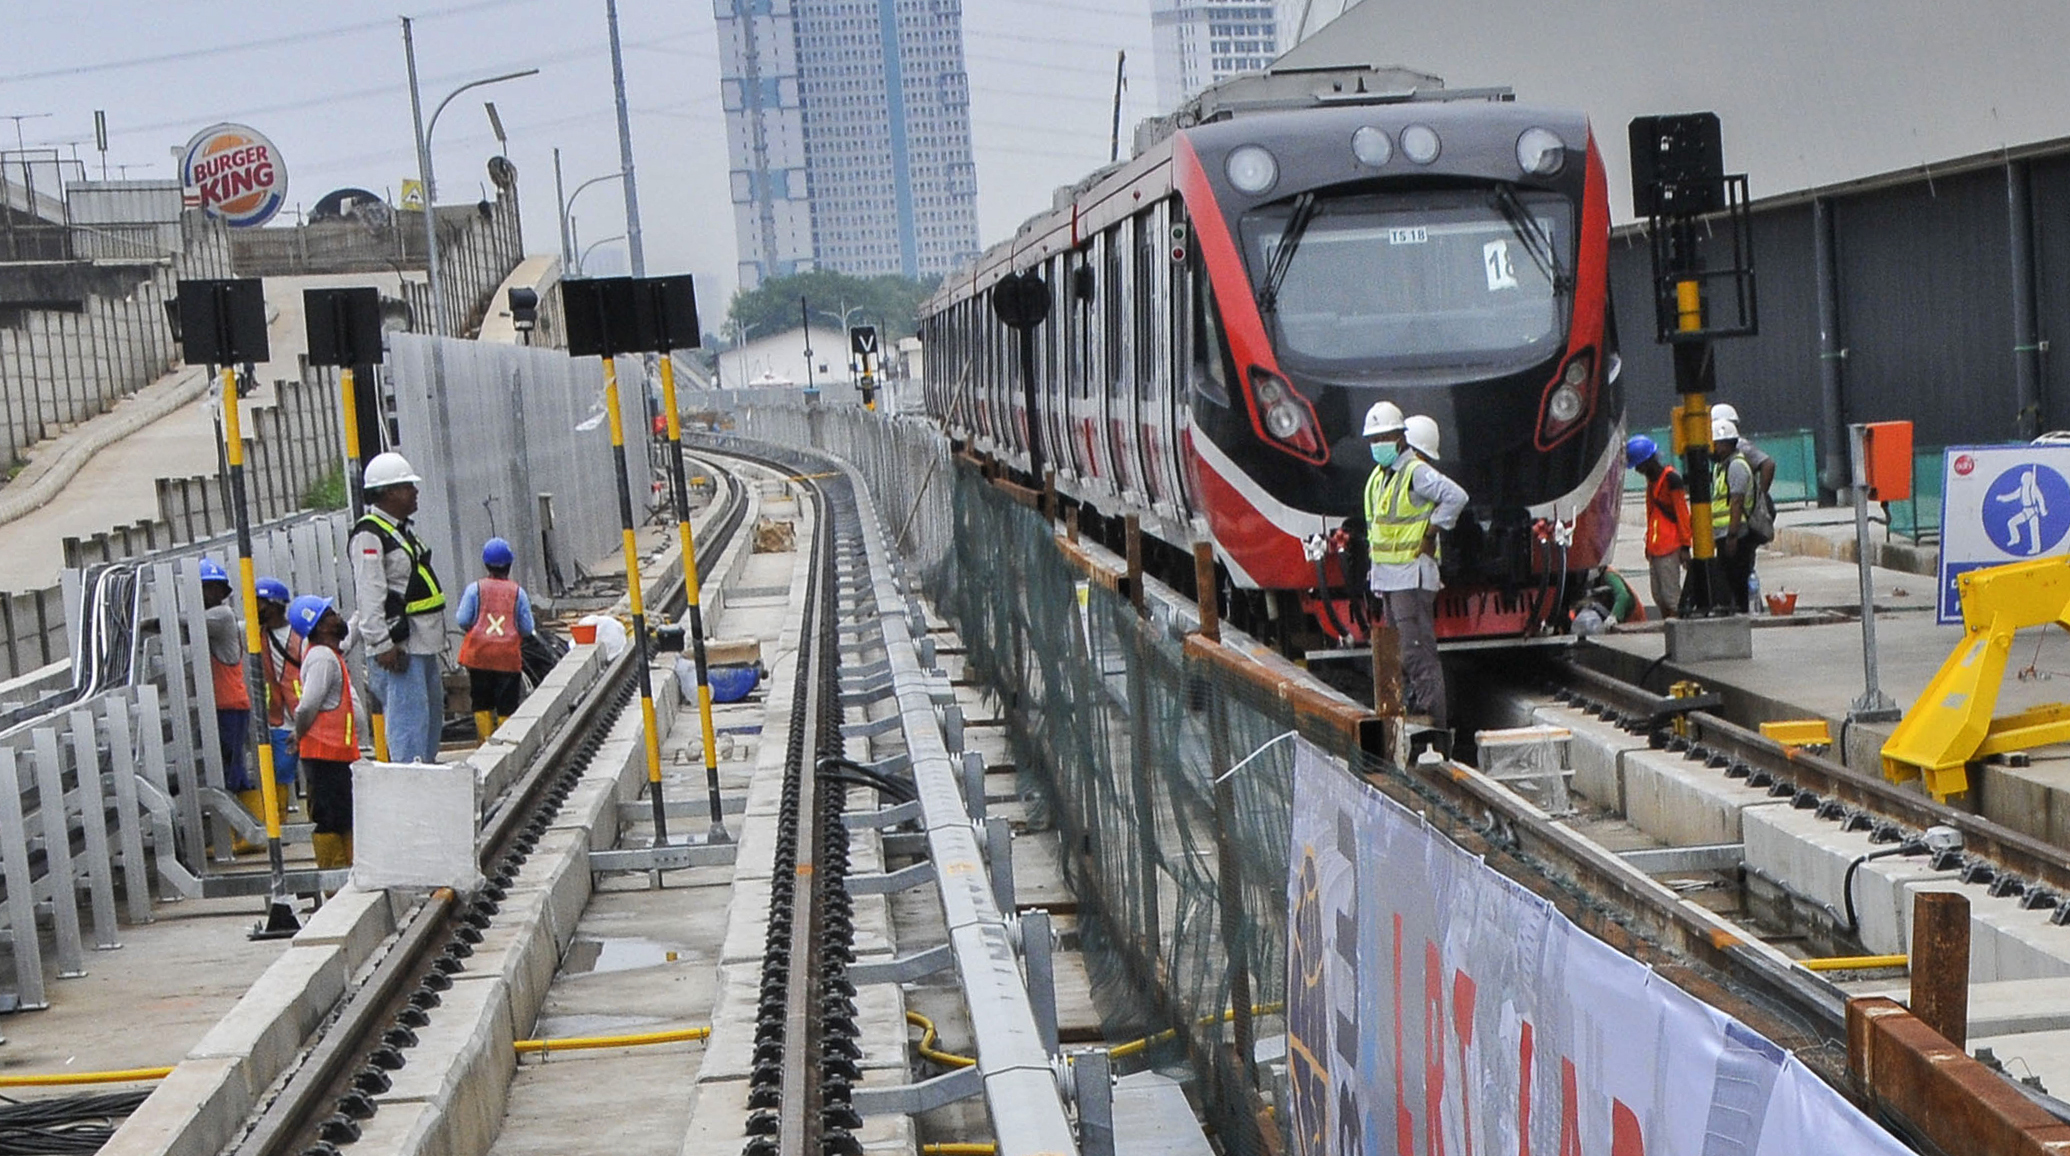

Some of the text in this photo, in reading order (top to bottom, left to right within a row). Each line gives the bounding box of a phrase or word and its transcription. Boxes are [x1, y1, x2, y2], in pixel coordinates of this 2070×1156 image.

[193, 145, 269, 184] BURGER
[200, 162, 274, 208] KING
[1411, 229, 1425, 241] 18
[858, 334, 875, 352] V
